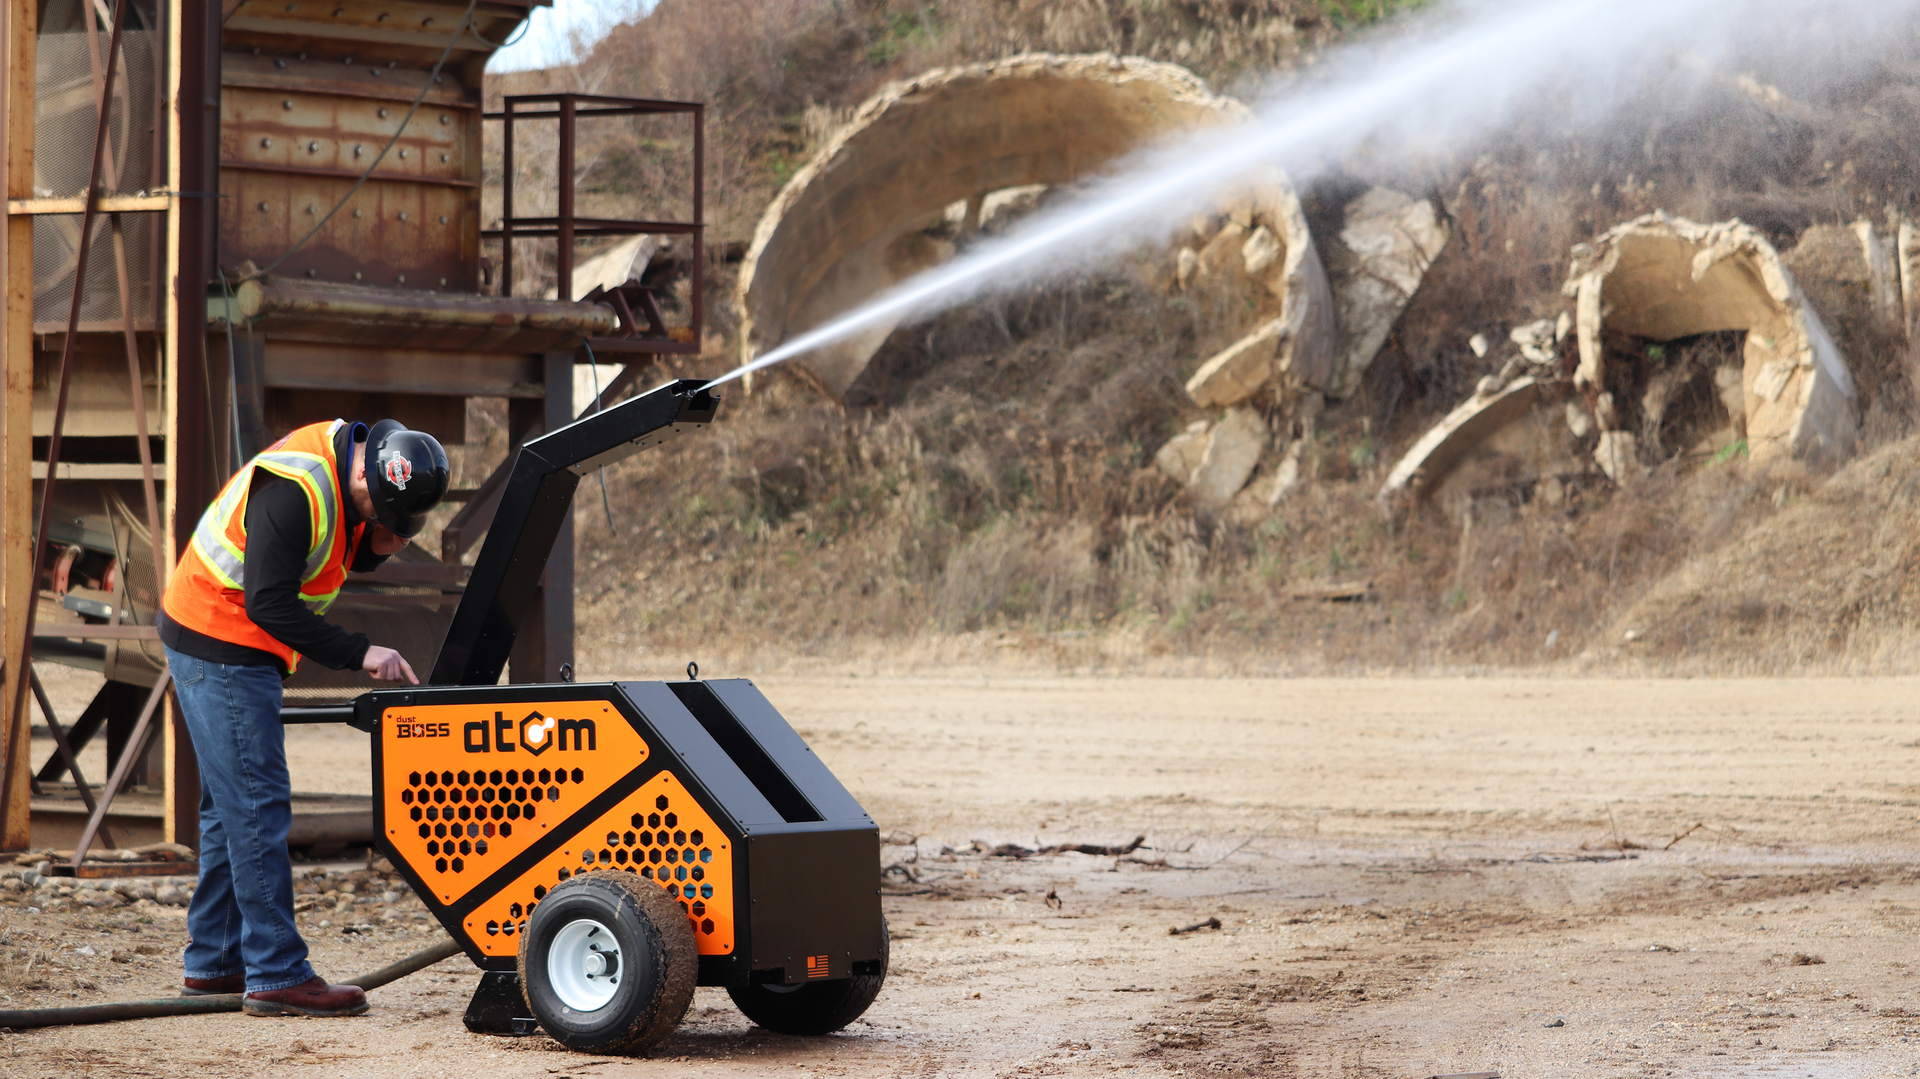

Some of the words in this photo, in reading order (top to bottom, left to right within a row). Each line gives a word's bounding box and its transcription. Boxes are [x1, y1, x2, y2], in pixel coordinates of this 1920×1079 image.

[396, 715, 417, 723] dust
[396, 722, 450, 739] BOSS
[463, 710, 597, 757] atom
